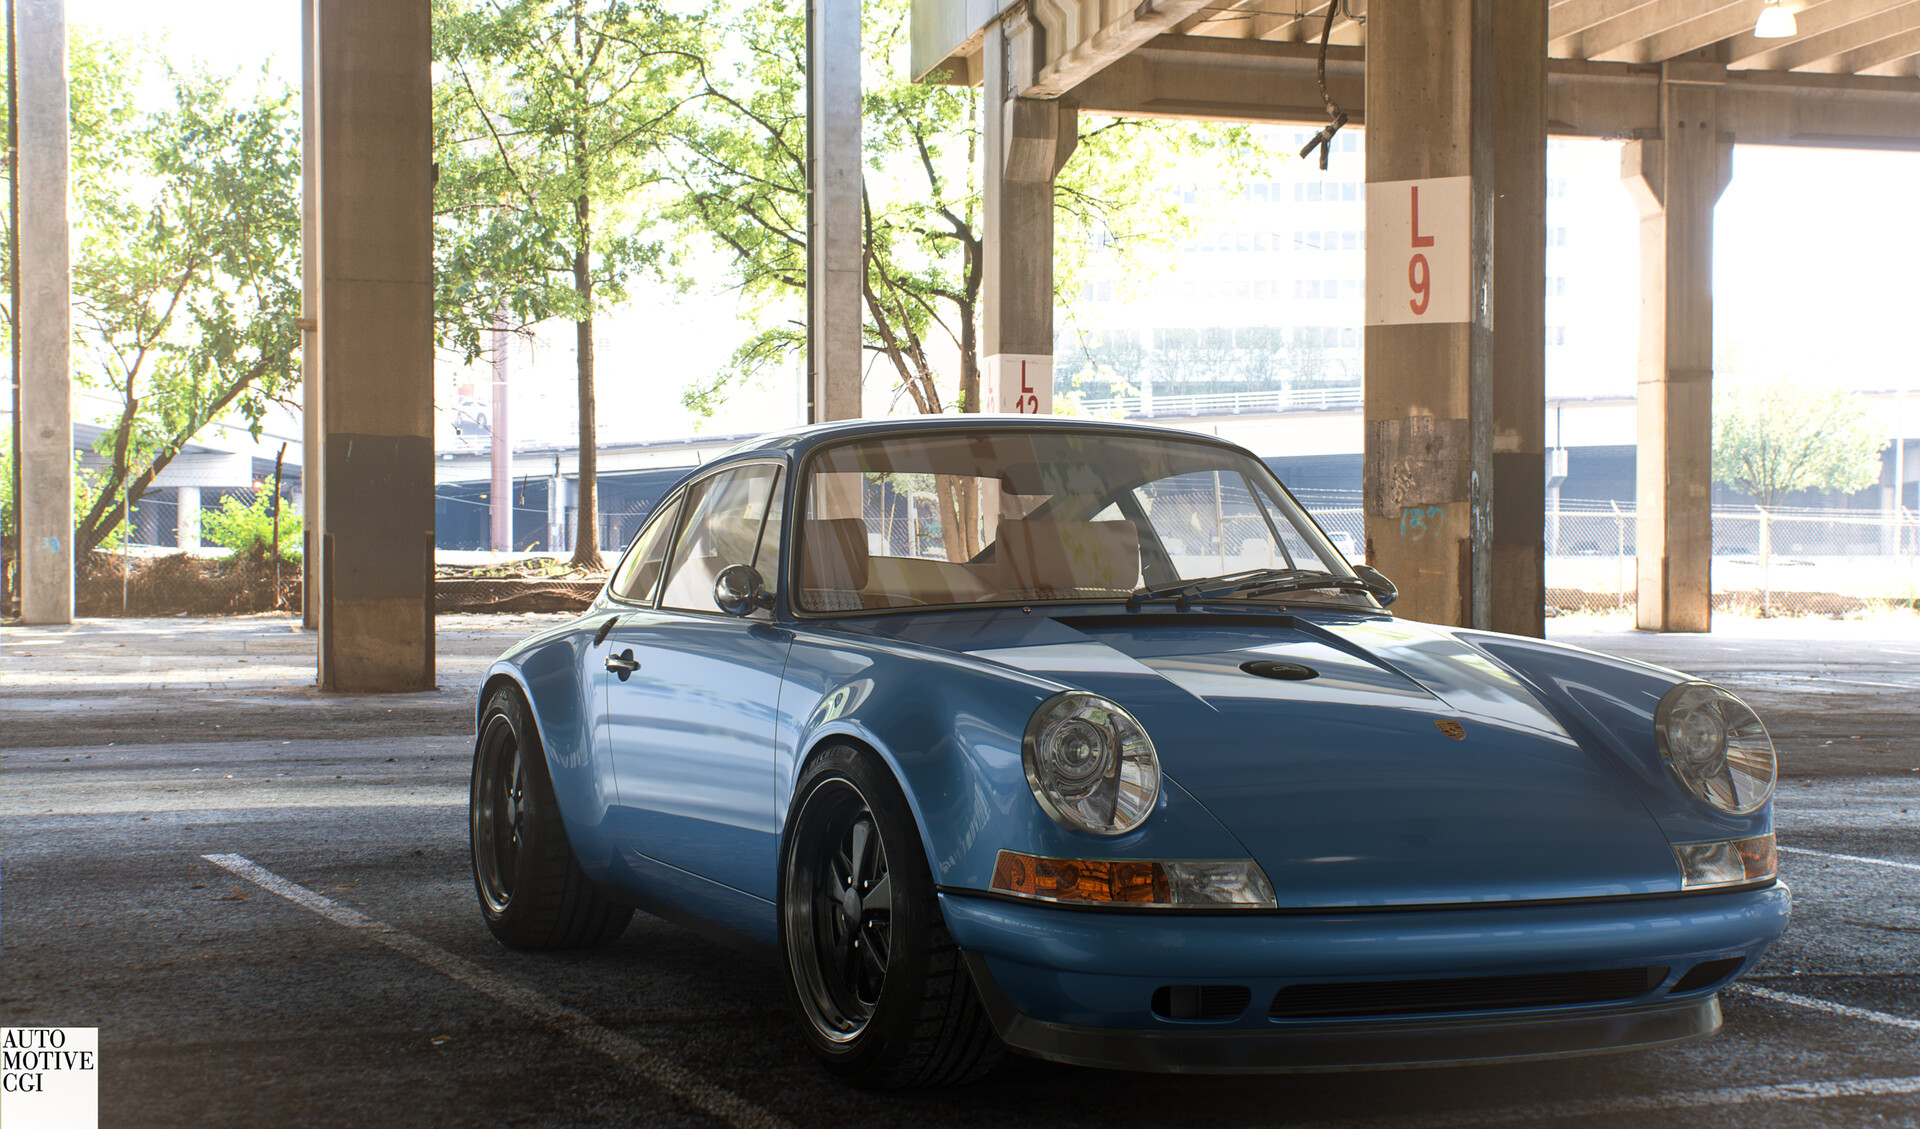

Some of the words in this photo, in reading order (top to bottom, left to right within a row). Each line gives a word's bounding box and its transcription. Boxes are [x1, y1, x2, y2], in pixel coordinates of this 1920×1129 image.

[1411, 186, 1434, 248] L
[1408, 253, 1430, 315] 9
[1022, 360, 1033, 393] L
